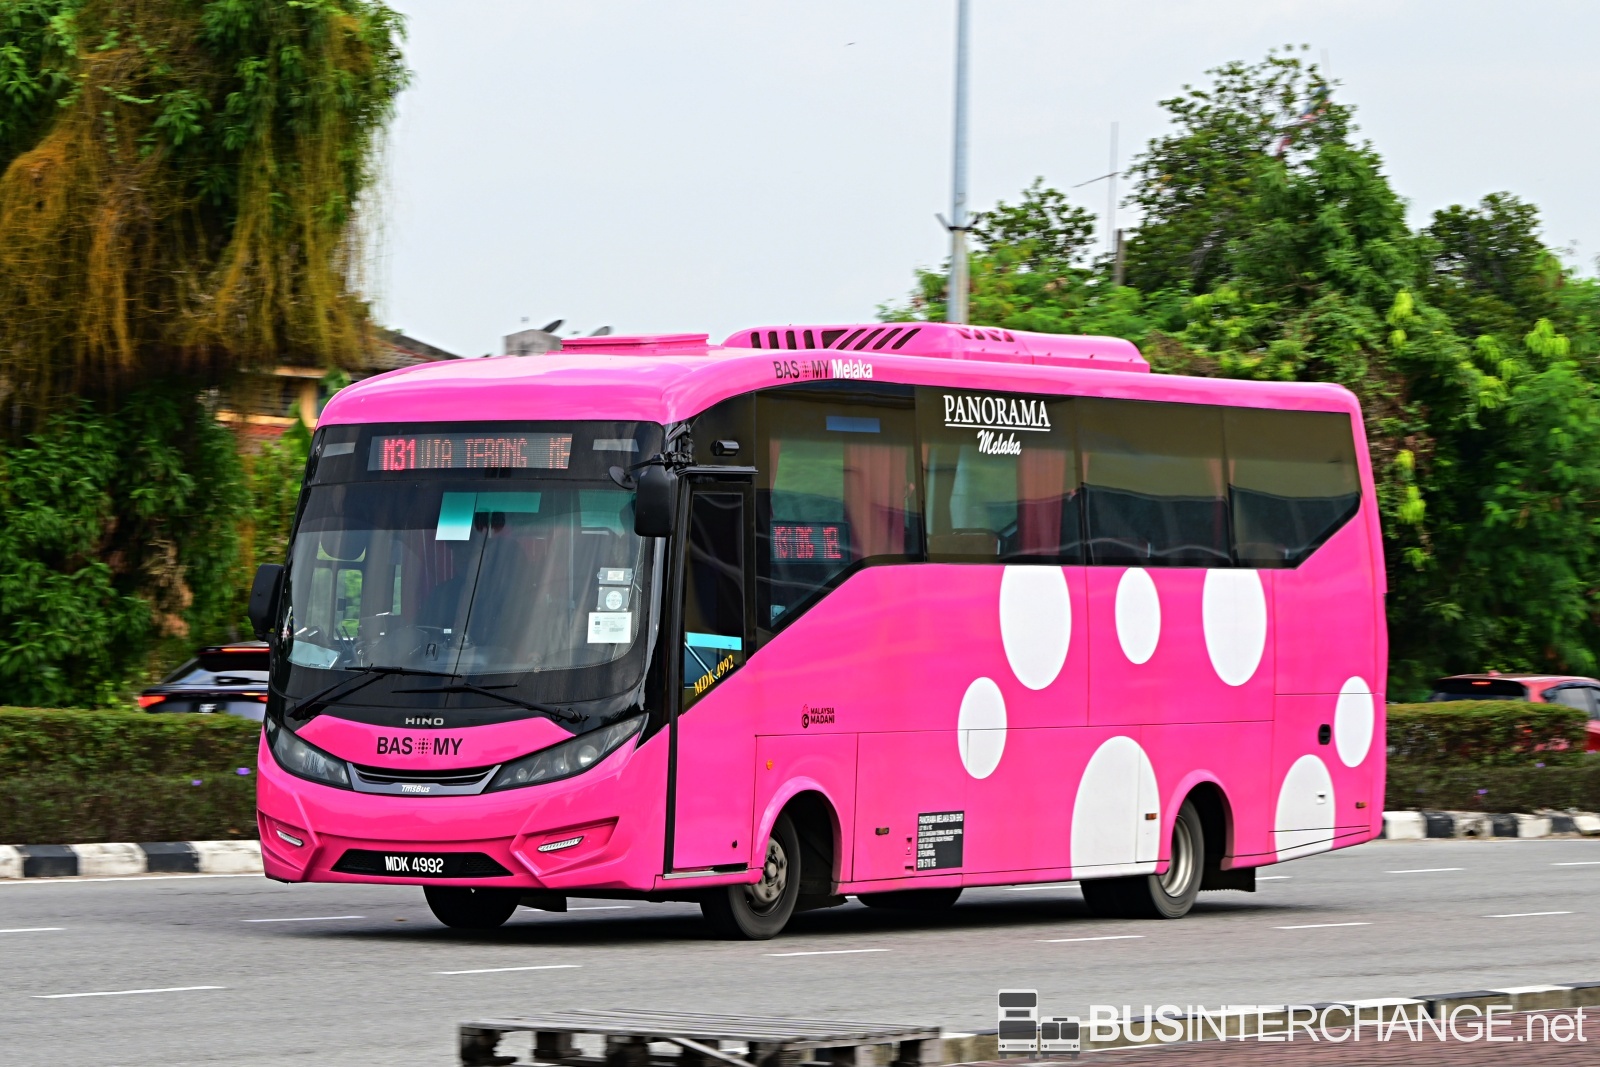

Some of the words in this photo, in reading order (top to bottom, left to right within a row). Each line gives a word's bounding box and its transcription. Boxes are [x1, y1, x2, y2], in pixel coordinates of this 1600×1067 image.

[773, 360, 800, 379] BAS
[812, 361, 829, 379] MY
[832, 359, 873, 379] Melaka
[943, 394, 1051, 428] PANORAMA
[977, 429, 1022, 456] Melaka
[383, 438, 417, 471] M31
[694, 671, 716, 696] MDK
[715, 654, 734, 679] 4992
[810, 707, 835, 715] MALAYSIA
[810, 715, 835, 724] MADANI
[405, 717, 444, 726] HINO
[376, 736, 413, 755] BAS
[433, 737, 463, 755] MY
[385, 856, 410, 872] MDK
[412, 857, 444, 873] 4992
